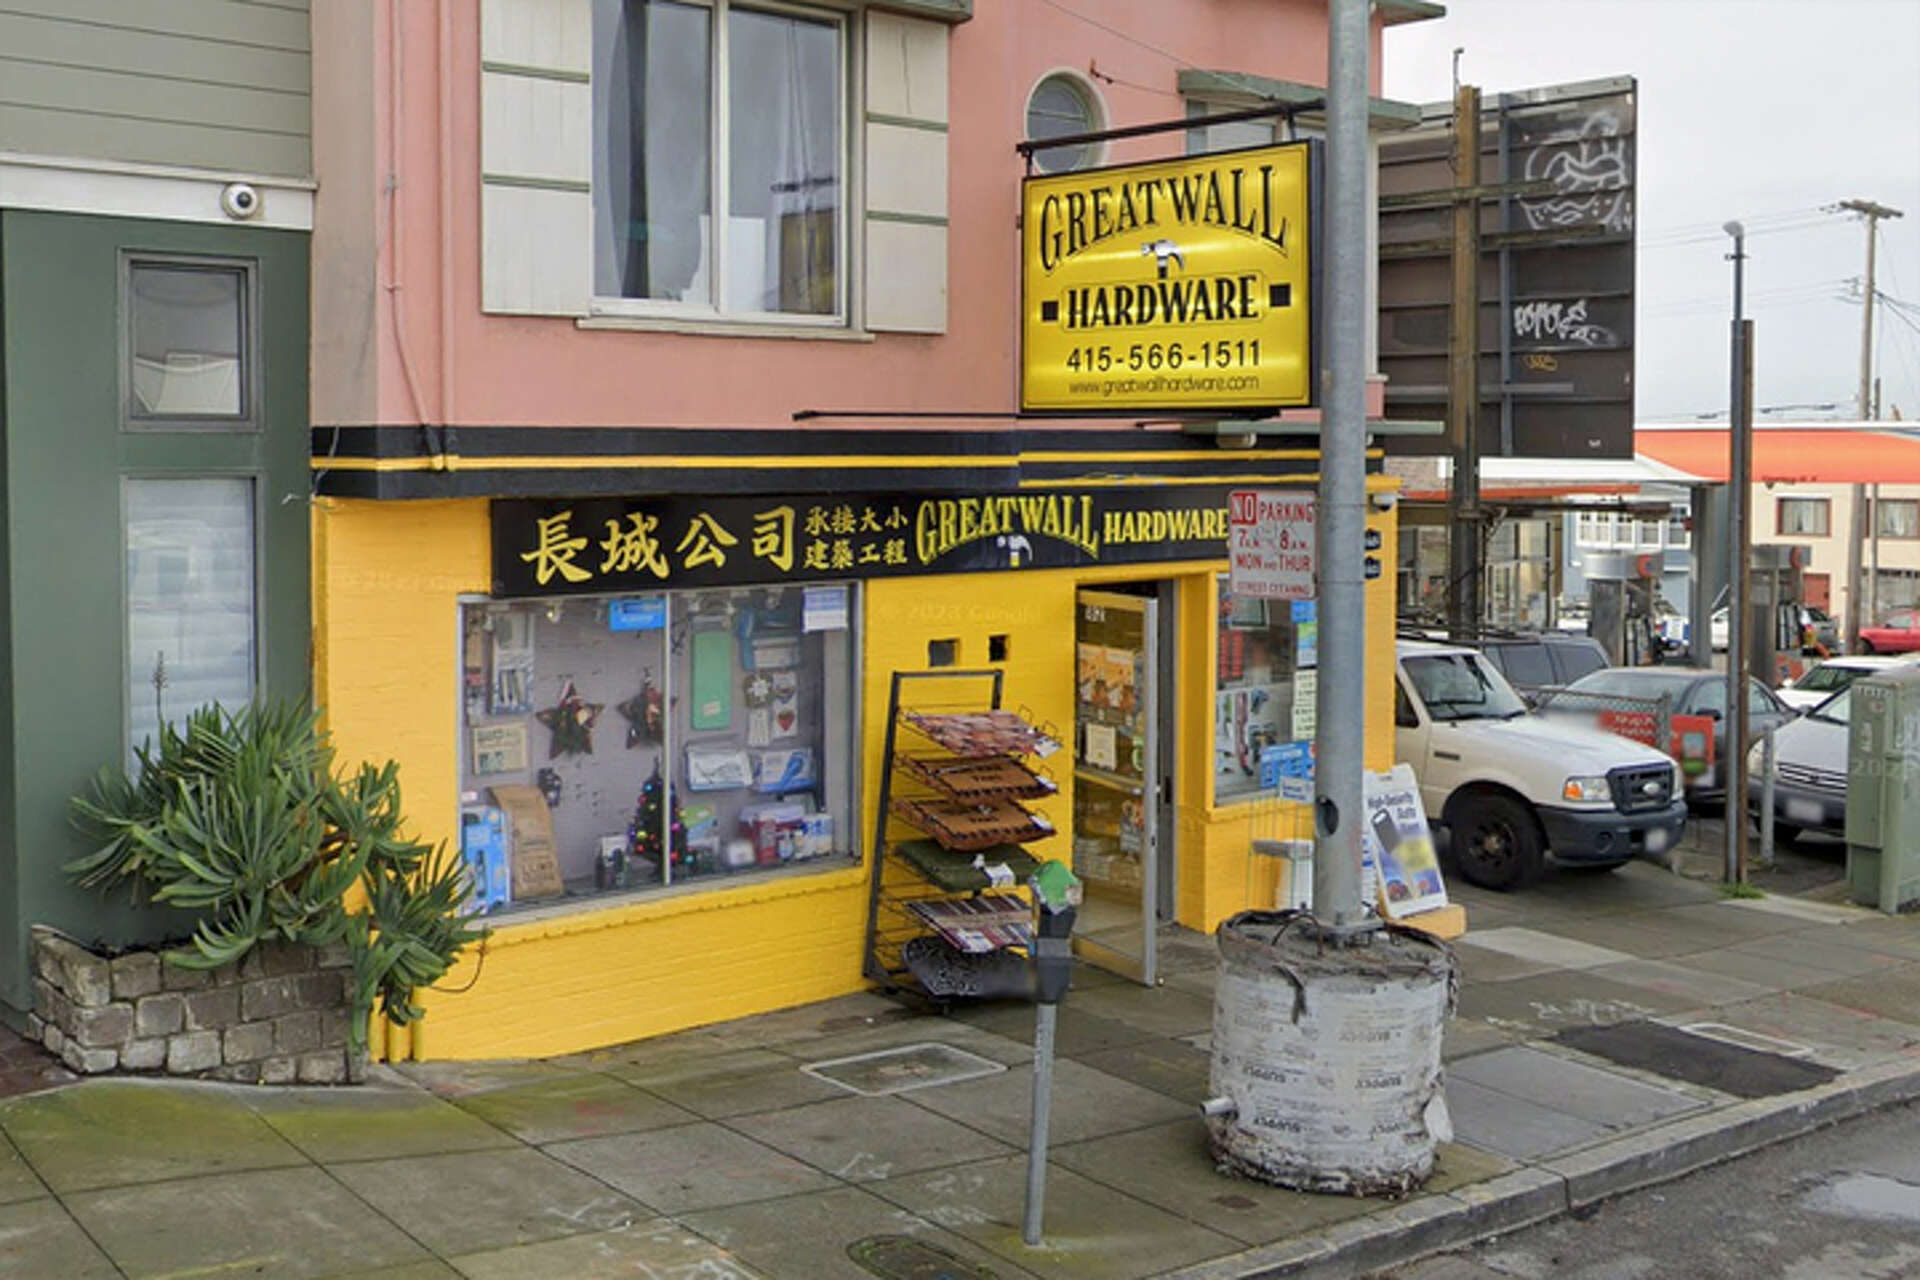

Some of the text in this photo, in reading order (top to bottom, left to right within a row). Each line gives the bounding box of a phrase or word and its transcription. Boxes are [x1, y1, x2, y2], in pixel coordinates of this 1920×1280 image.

[1066, 275, 1259, 329] HARDWARE
[1066, 340, 1261, 372] 415-566-1511
[1069, 375, 1260, 397] www.greatwallhardware.com
[1103, 507, 1228, 544] HARDWARE
[1259, 501, 1314, 523] PARKING
[520, 505, 796, 586] 長城公司
